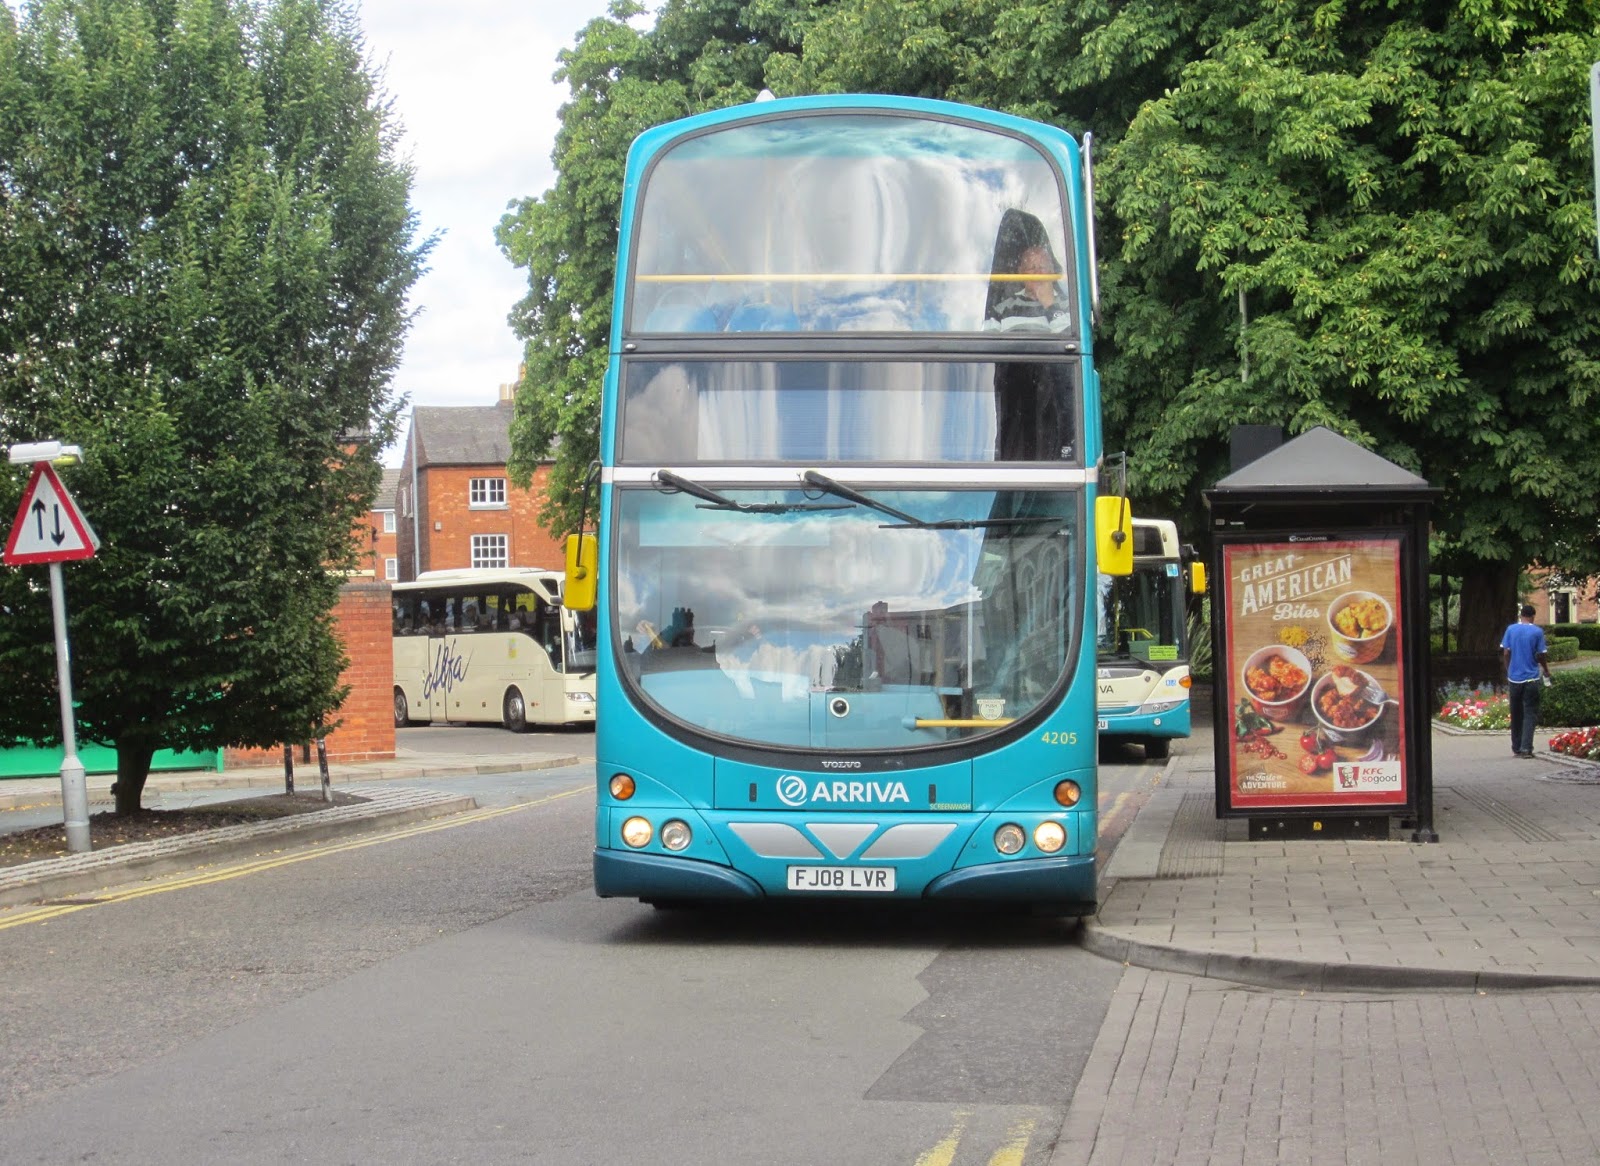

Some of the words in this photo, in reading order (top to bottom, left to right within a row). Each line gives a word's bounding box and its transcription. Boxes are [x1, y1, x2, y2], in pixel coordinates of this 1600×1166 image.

[1240, 554, 1295, 583] GREAT
[1240, 557, 1352, 617] AMERICAN
[1272, 602, 1320, 621] Bites
[1041, 731, 1078, 745] 4205
[821, 761, 861, 769] VOLVO
[811, 782, 910, 803] ARRIVA
[1242, 781, 1287, 789] ADVENTURE
[929, 803, 971, 811] SCREENWASH
[795, 869, 844, 887] FJ08
[850, 870, 887, 888] LVR
